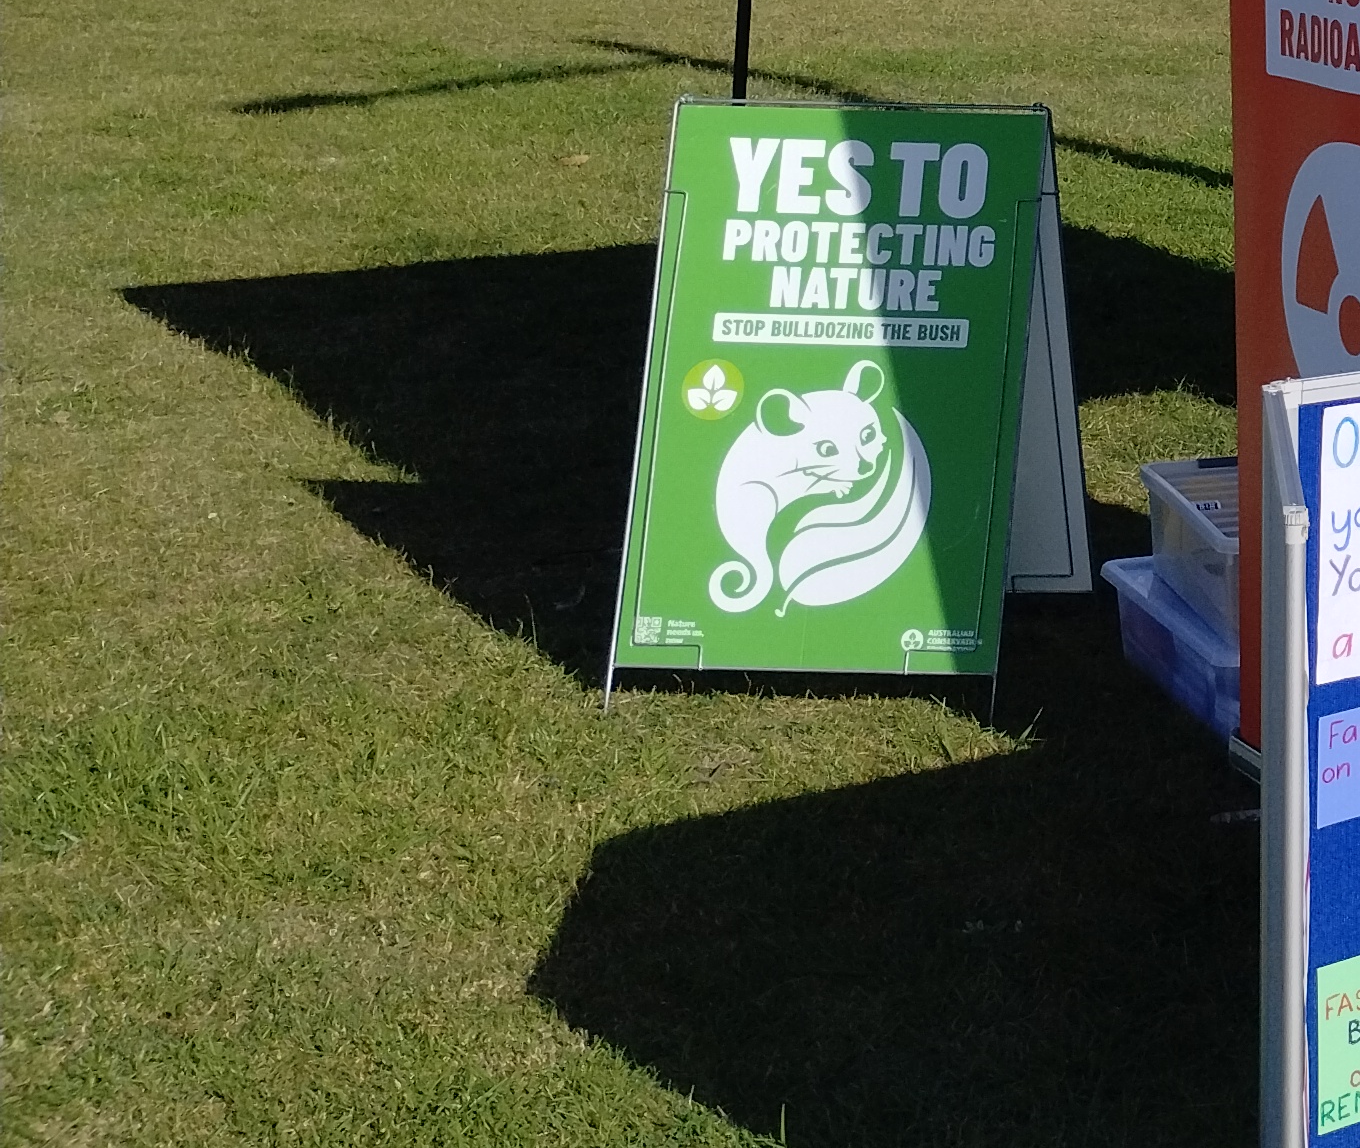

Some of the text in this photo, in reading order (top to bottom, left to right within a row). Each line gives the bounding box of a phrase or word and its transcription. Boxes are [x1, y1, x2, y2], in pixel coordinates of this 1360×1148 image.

[730, 136, 990, 219] YES TO
[722, 219, 996, 268] PROTECTING
[769, 265, 942, 312] NATURE
[721, 317, 962, 343] STOP BULLDOZING THE BUSH
[1331, 631, 1354, 659] a
[1322, 759, 1351, 785] on
